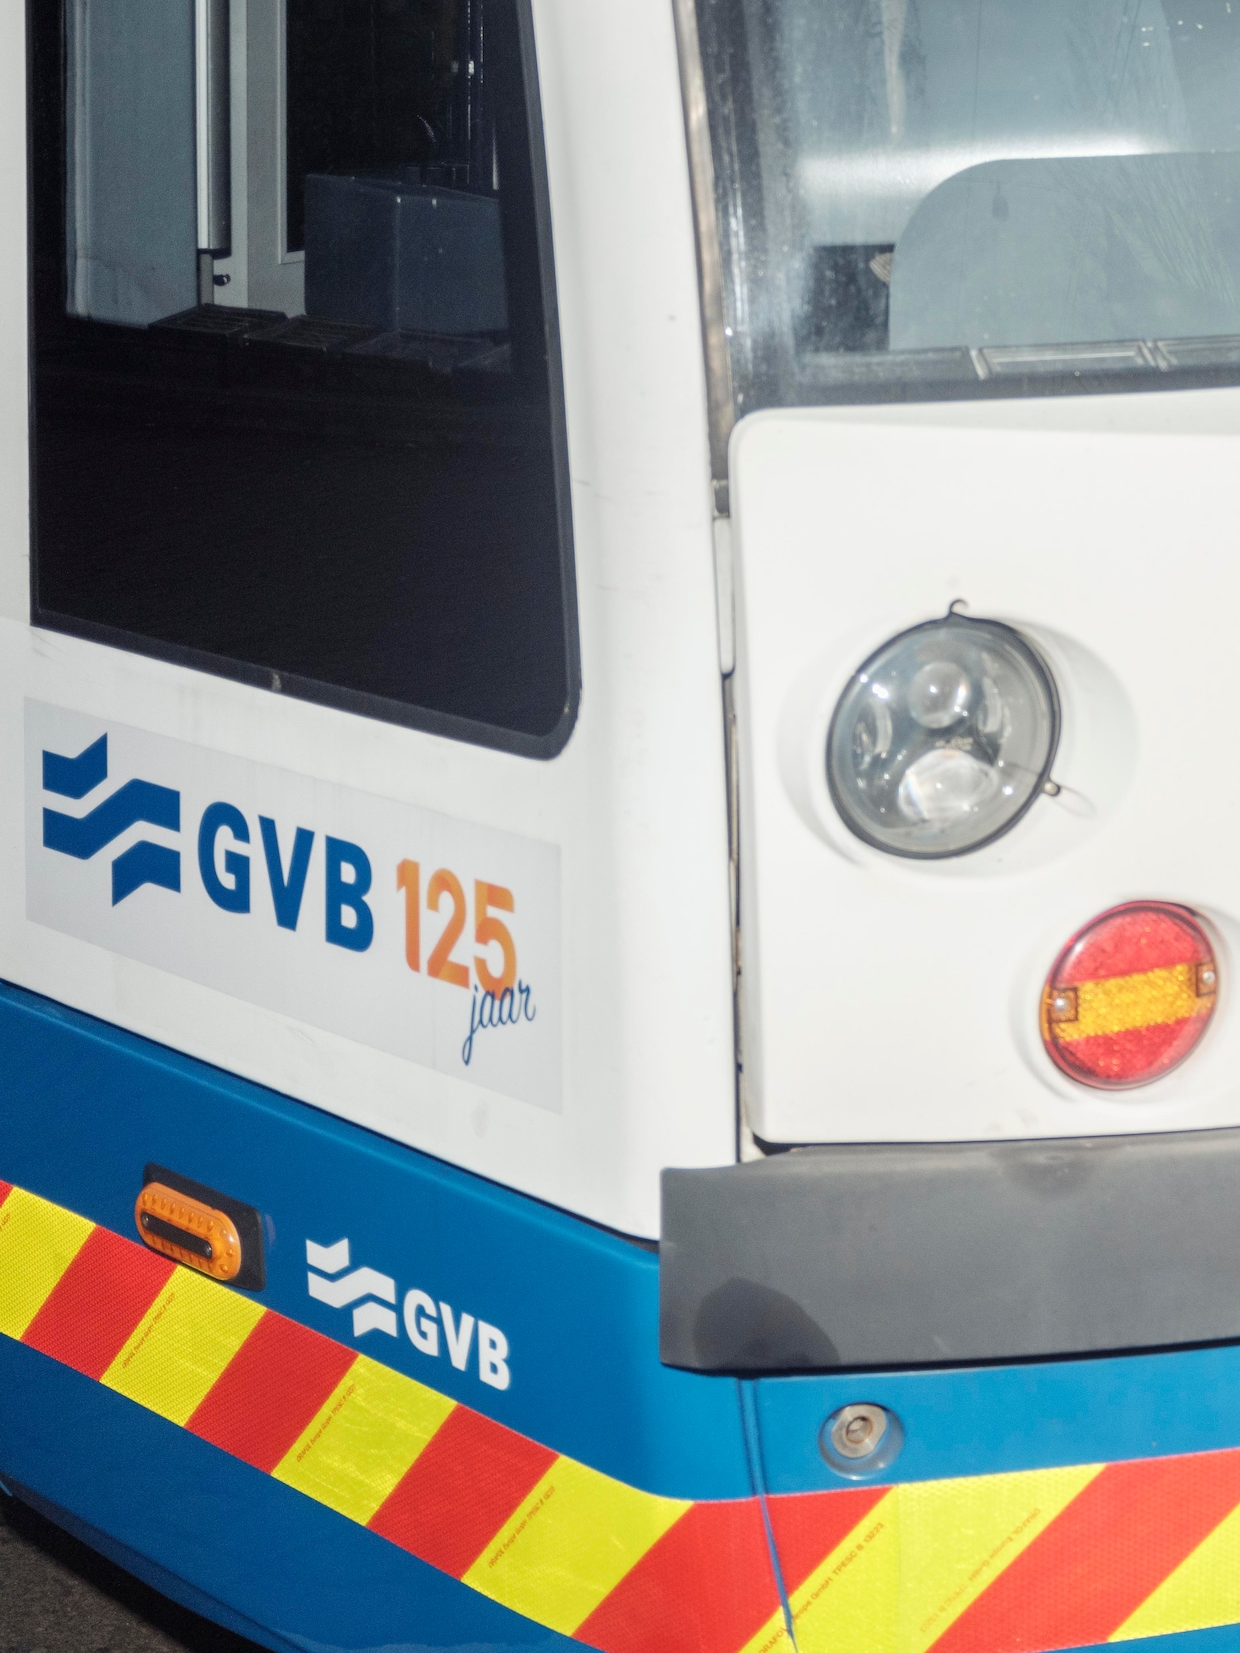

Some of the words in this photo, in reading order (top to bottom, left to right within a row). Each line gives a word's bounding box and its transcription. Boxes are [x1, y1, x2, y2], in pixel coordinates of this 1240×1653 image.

[198, 801, 374, 953] GVB
[396, 857, 518, 1002] 125
[462, 979, 537, 1066] jaar
[403, 1288, 512, 1391] GVB
